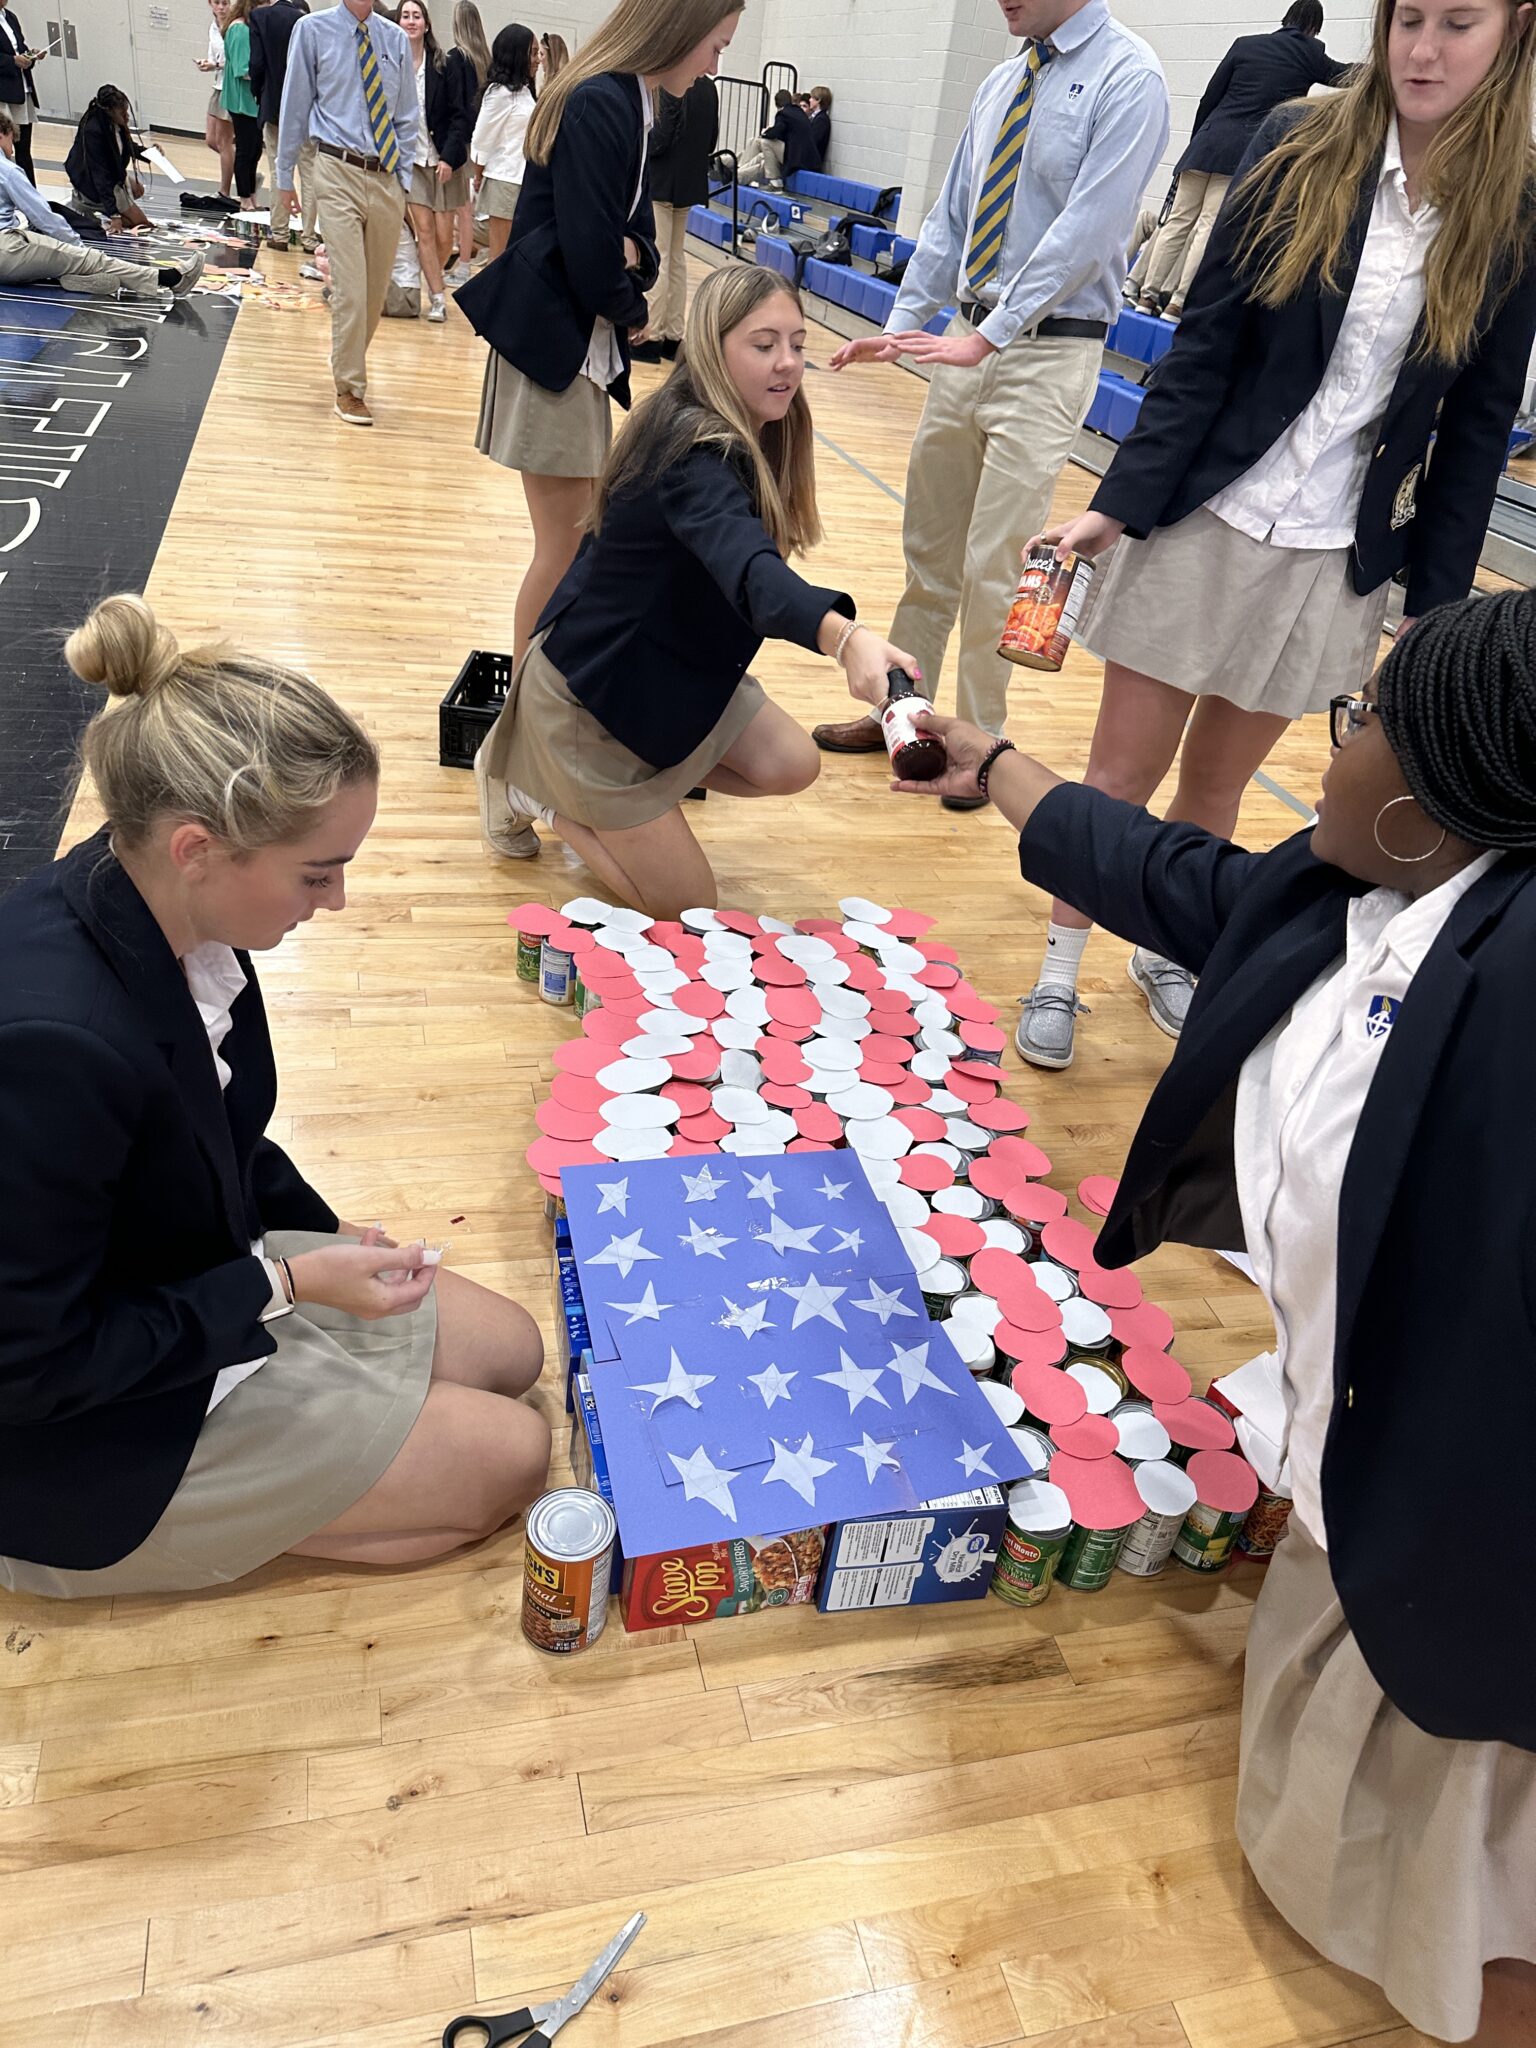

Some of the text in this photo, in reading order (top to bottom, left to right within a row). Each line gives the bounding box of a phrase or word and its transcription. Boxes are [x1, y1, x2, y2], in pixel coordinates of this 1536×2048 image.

[734, 1540, 750, 1594] SAVORY HERBS
[1013, 1542, 1039, 1559] Monte
[652, 1557, 709, 1617] Stove
[692, 1561, 726, 1592] Top
